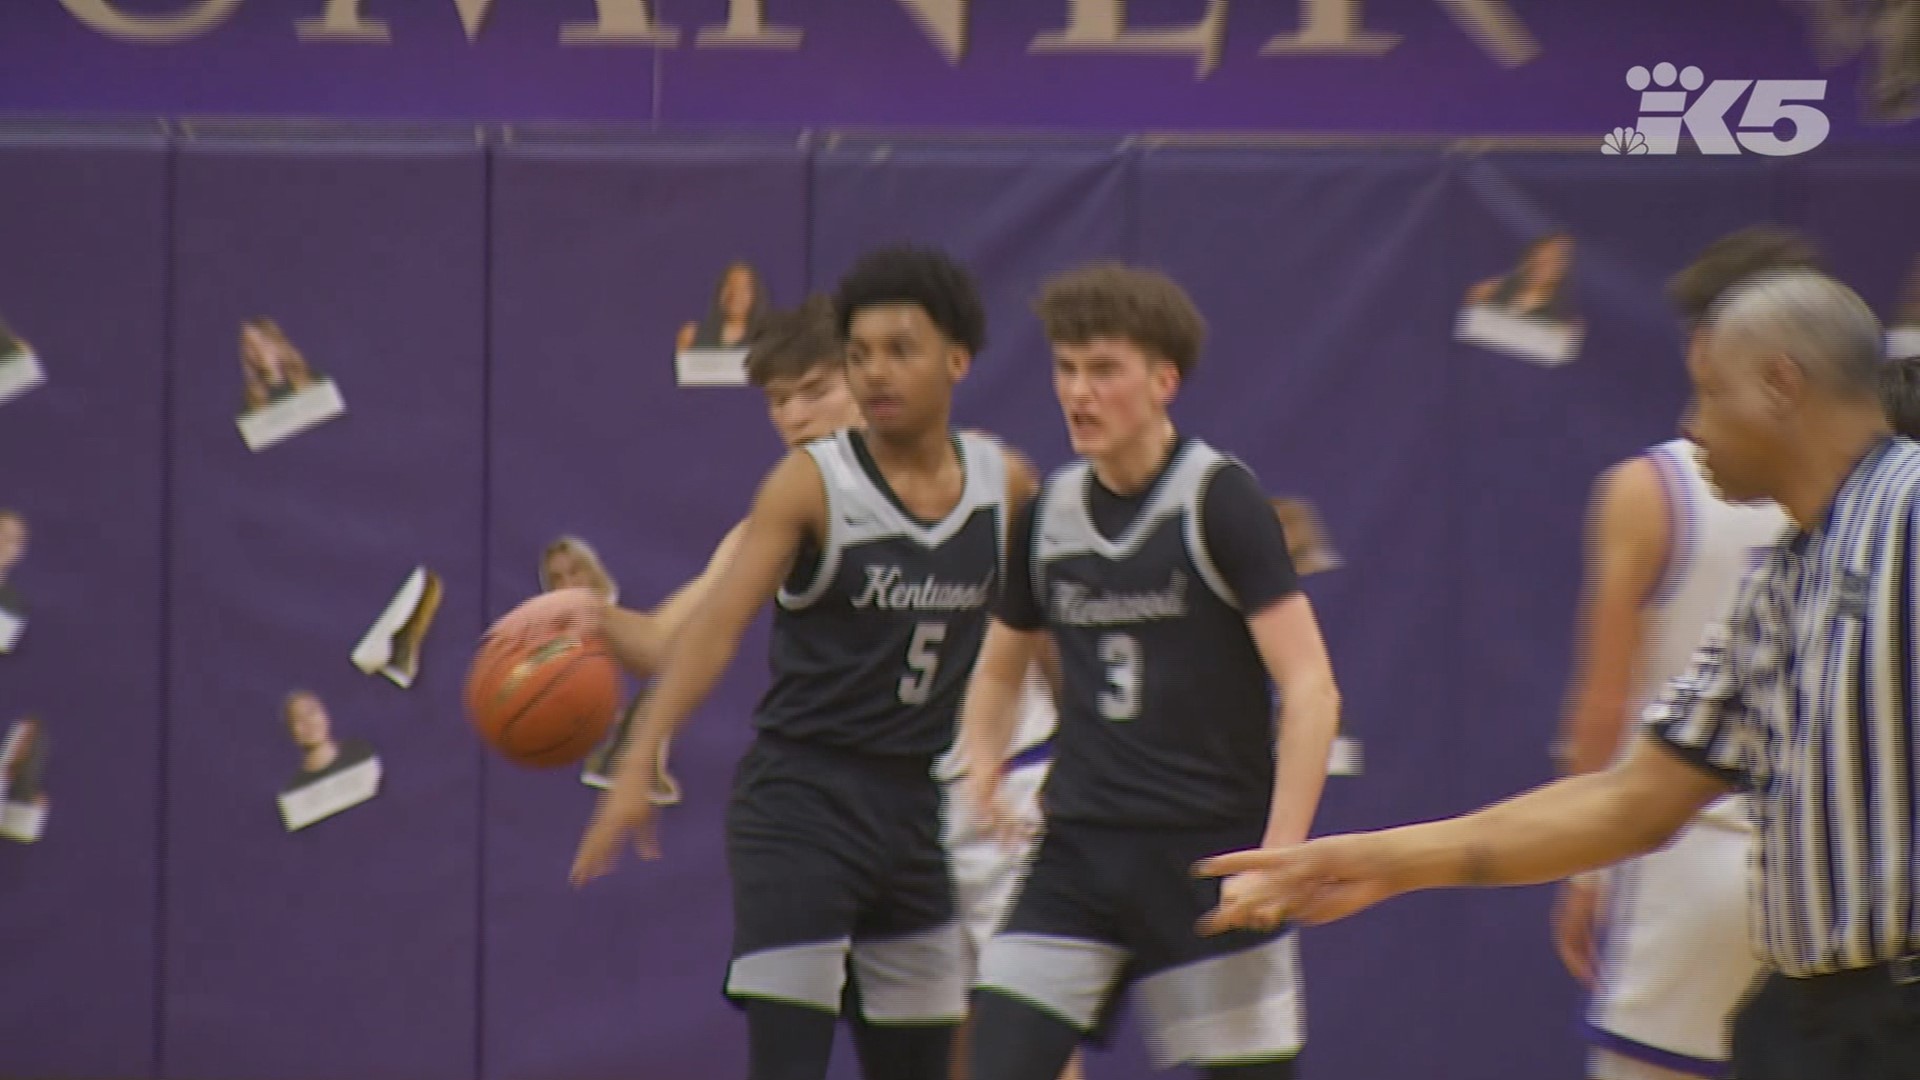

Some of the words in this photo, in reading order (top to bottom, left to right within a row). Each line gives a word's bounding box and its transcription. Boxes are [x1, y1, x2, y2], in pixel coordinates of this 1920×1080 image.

[851, 564, 996, 611] Kentwood
[900, 622, 946, 706] 5
[1098, 634, 1142, 721] 3
